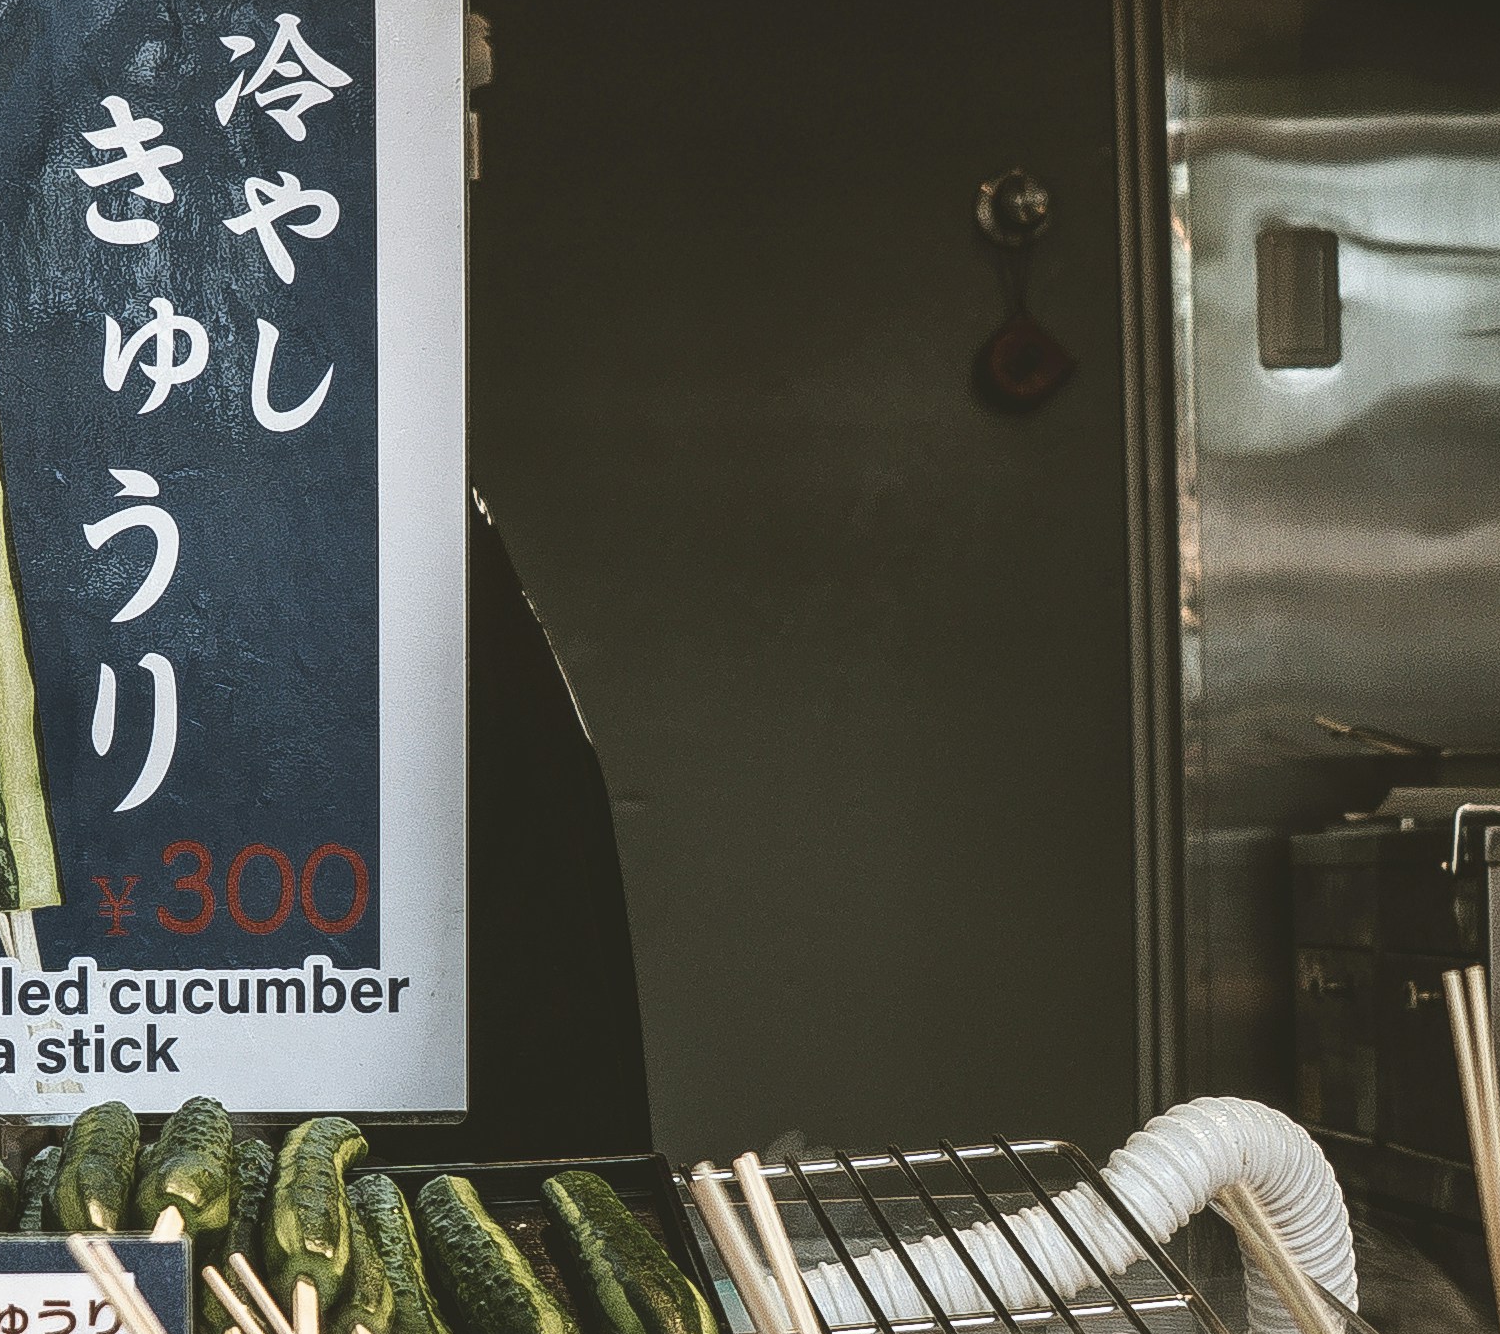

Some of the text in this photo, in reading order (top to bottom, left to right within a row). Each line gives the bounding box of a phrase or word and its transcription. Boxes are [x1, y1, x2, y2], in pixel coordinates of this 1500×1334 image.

[214, 12, 354, 433] 冷やし
[72, 95, 210, 814] きゅうり
[90, 839, 370, 939] ¥300
[108, 963, 410, 1017] cucumber
[36, 1027, 179, 1074] stick
